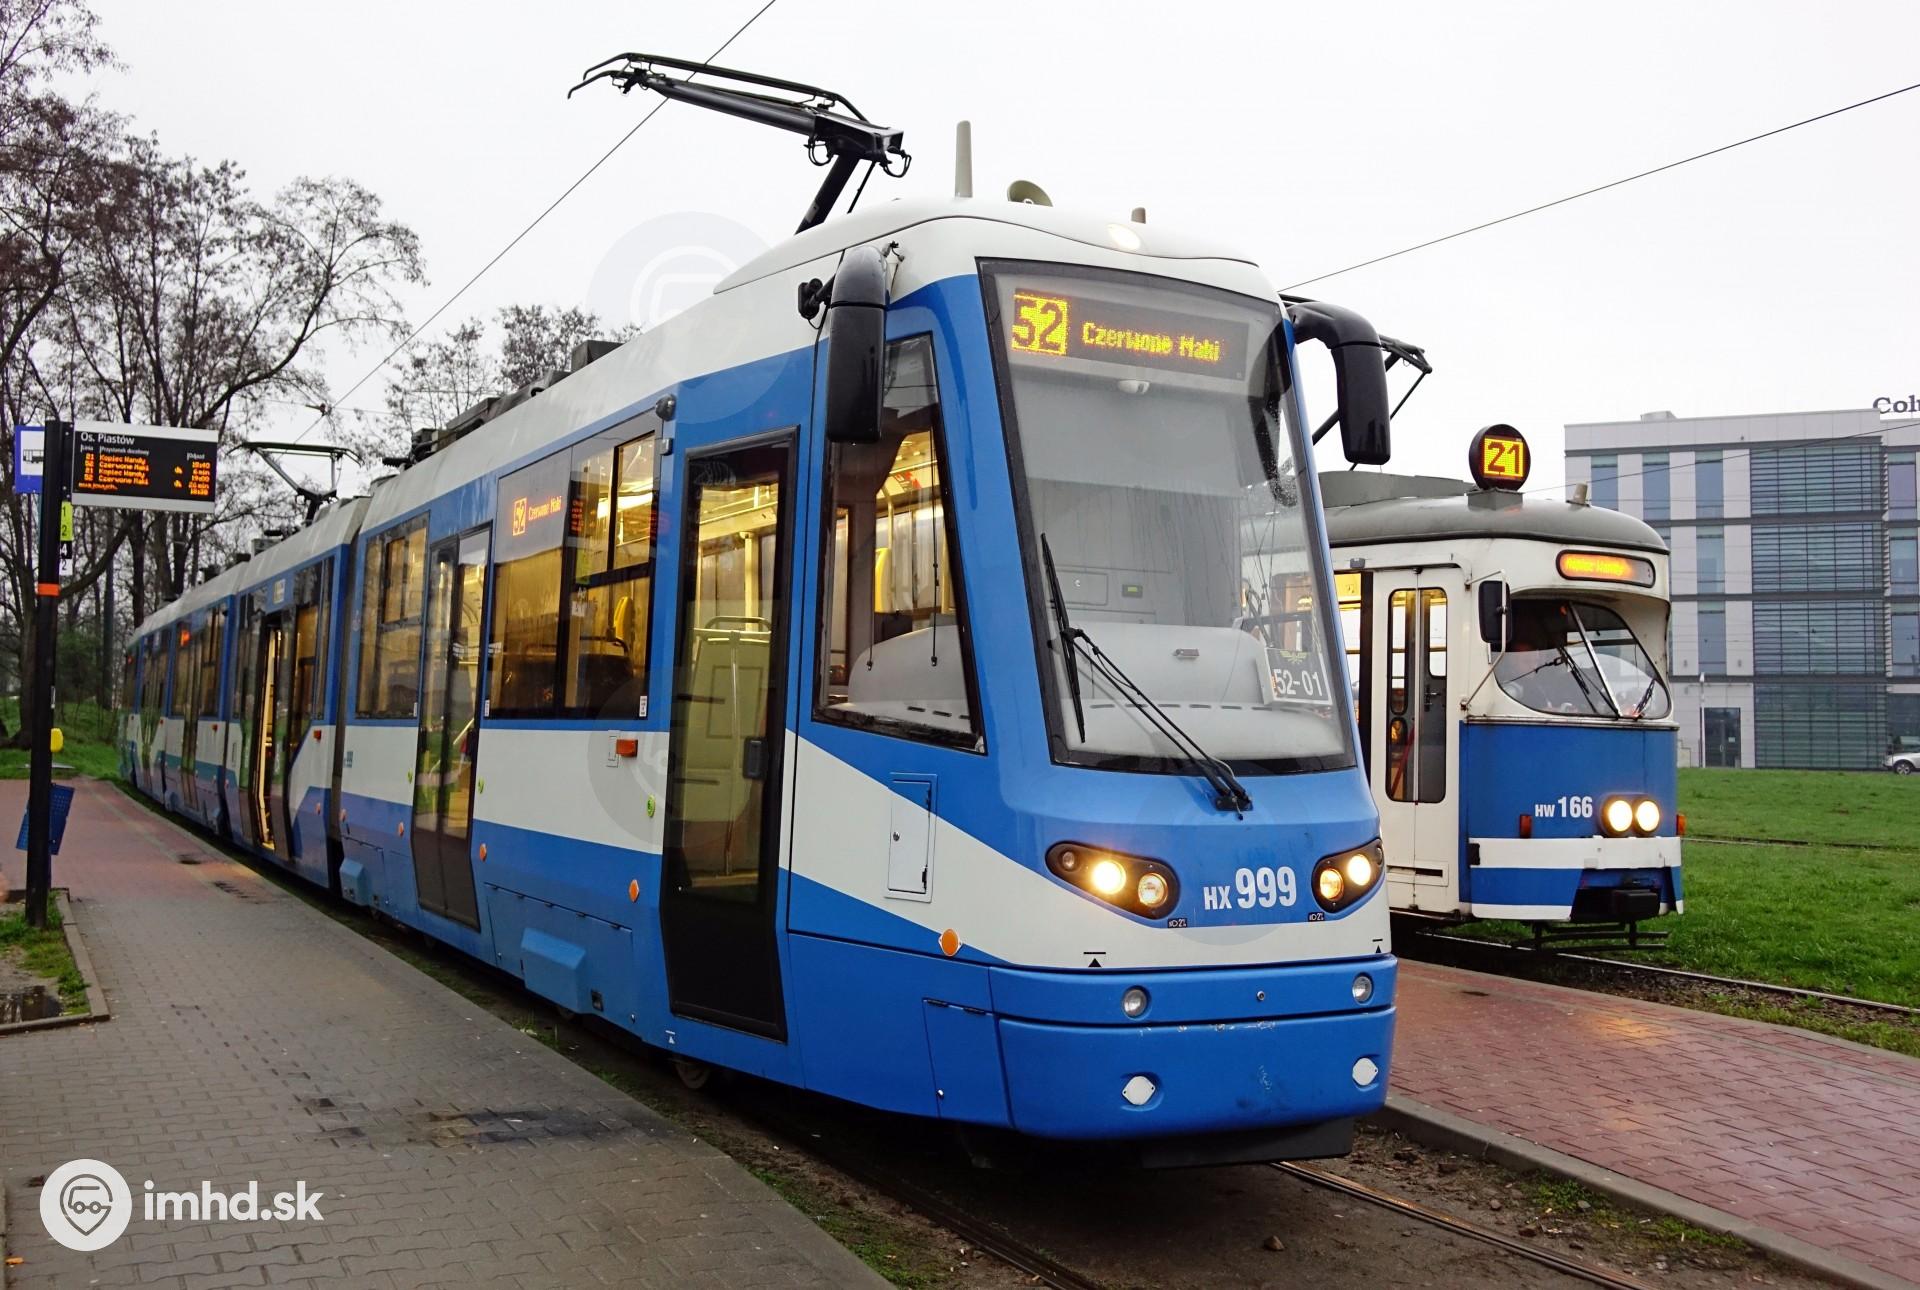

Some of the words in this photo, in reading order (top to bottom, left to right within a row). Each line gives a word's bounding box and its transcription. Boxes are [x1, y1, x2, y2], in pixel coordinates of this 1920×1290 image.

[1012, 299, 1064, 349] 52
[1082, 321, 1173, 355] Czerwone
[1179, 334, 1221, 362] Maki
[1873, 394, 1920, 414] Col
[80, 431, 95, 443] Os.
[98, 433, 135, 445] Piastów
[1487, 441, 1520, 474] 21
[514, 499, 526, 534] 52
[1273, 668, 1323, 697] 52-01
[1534, 804, 1556, 818] HW
[1558, 796, 1593, 818] 166
[1203, 886, 1232, 911] HX
[1235, 866, 1297, 909] 999
